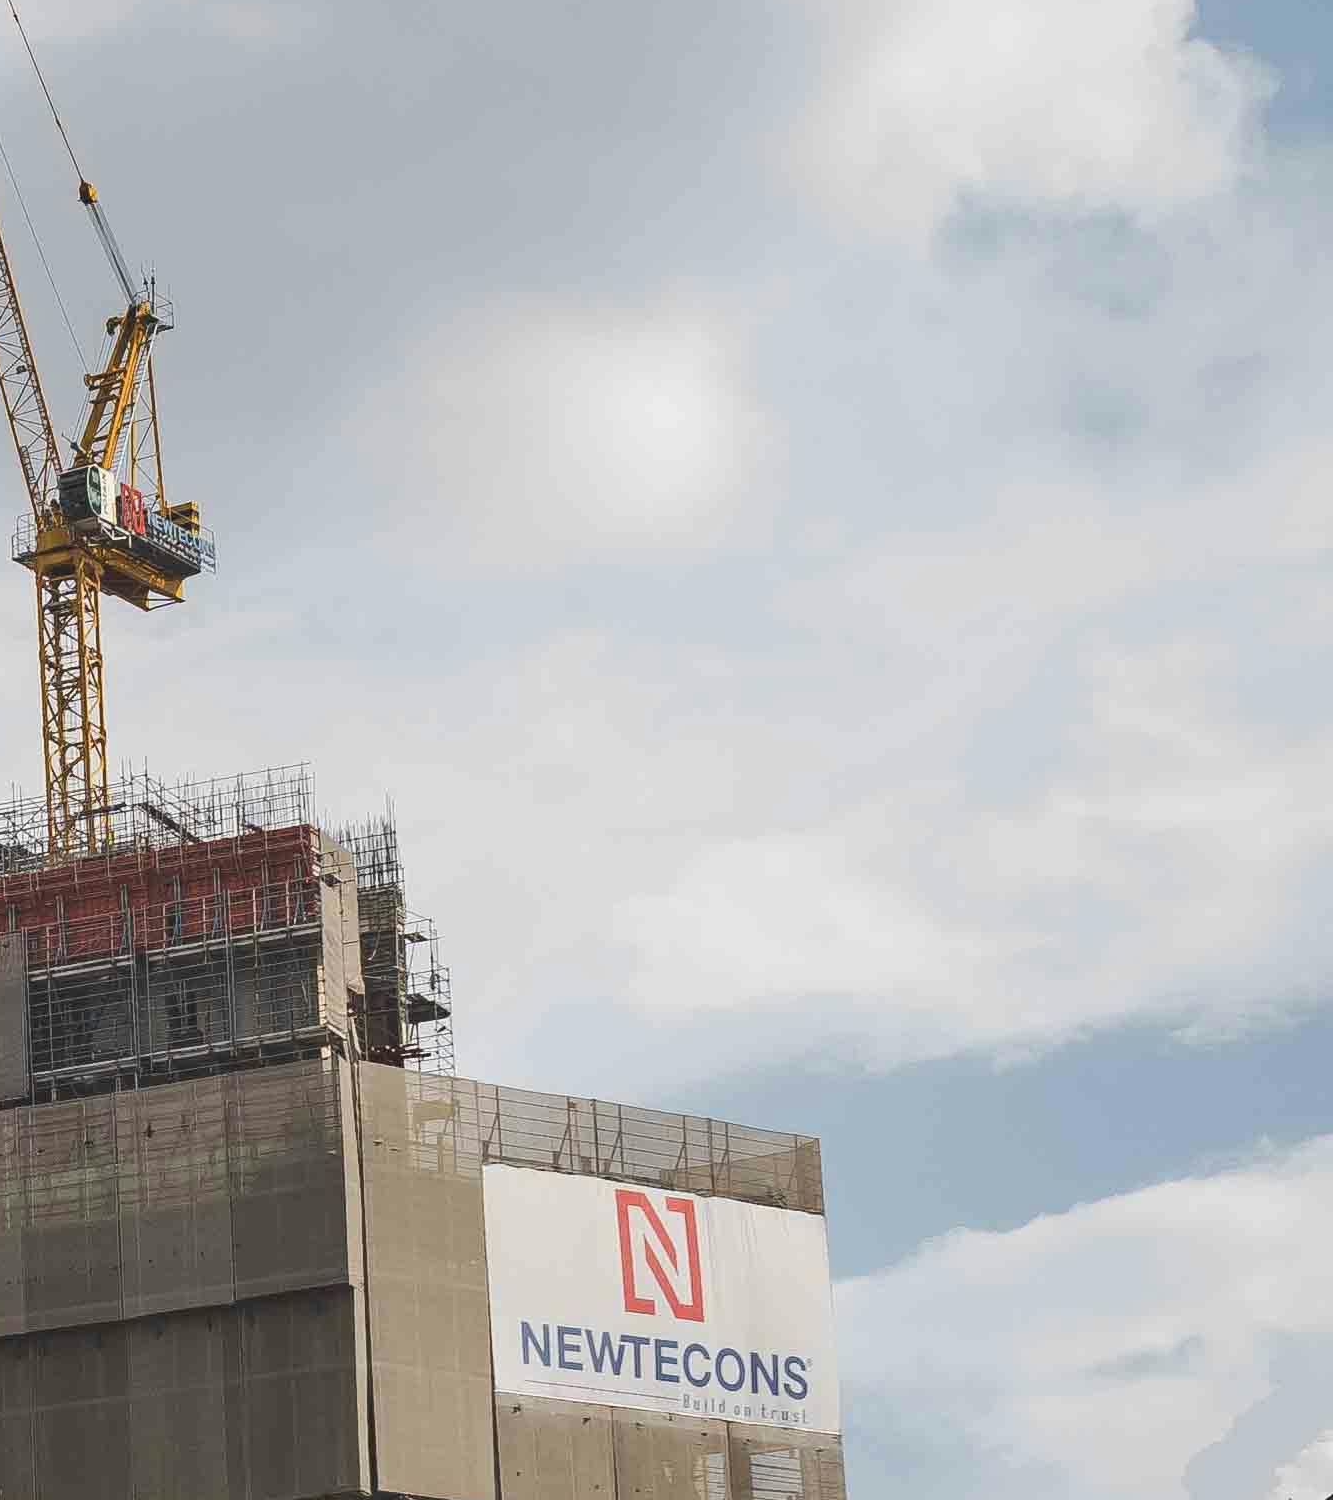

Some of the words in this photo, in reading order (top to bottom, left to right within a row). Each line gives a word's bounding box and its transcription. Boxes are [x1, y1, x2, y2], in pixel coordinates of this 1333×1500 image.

[521, 1321, 808, 1400] NEWTECONS
[683, 1394, 725, 1413] Build
[734, 1404, 752, 1417] on
[761, 1405, 808, 1424] trust
